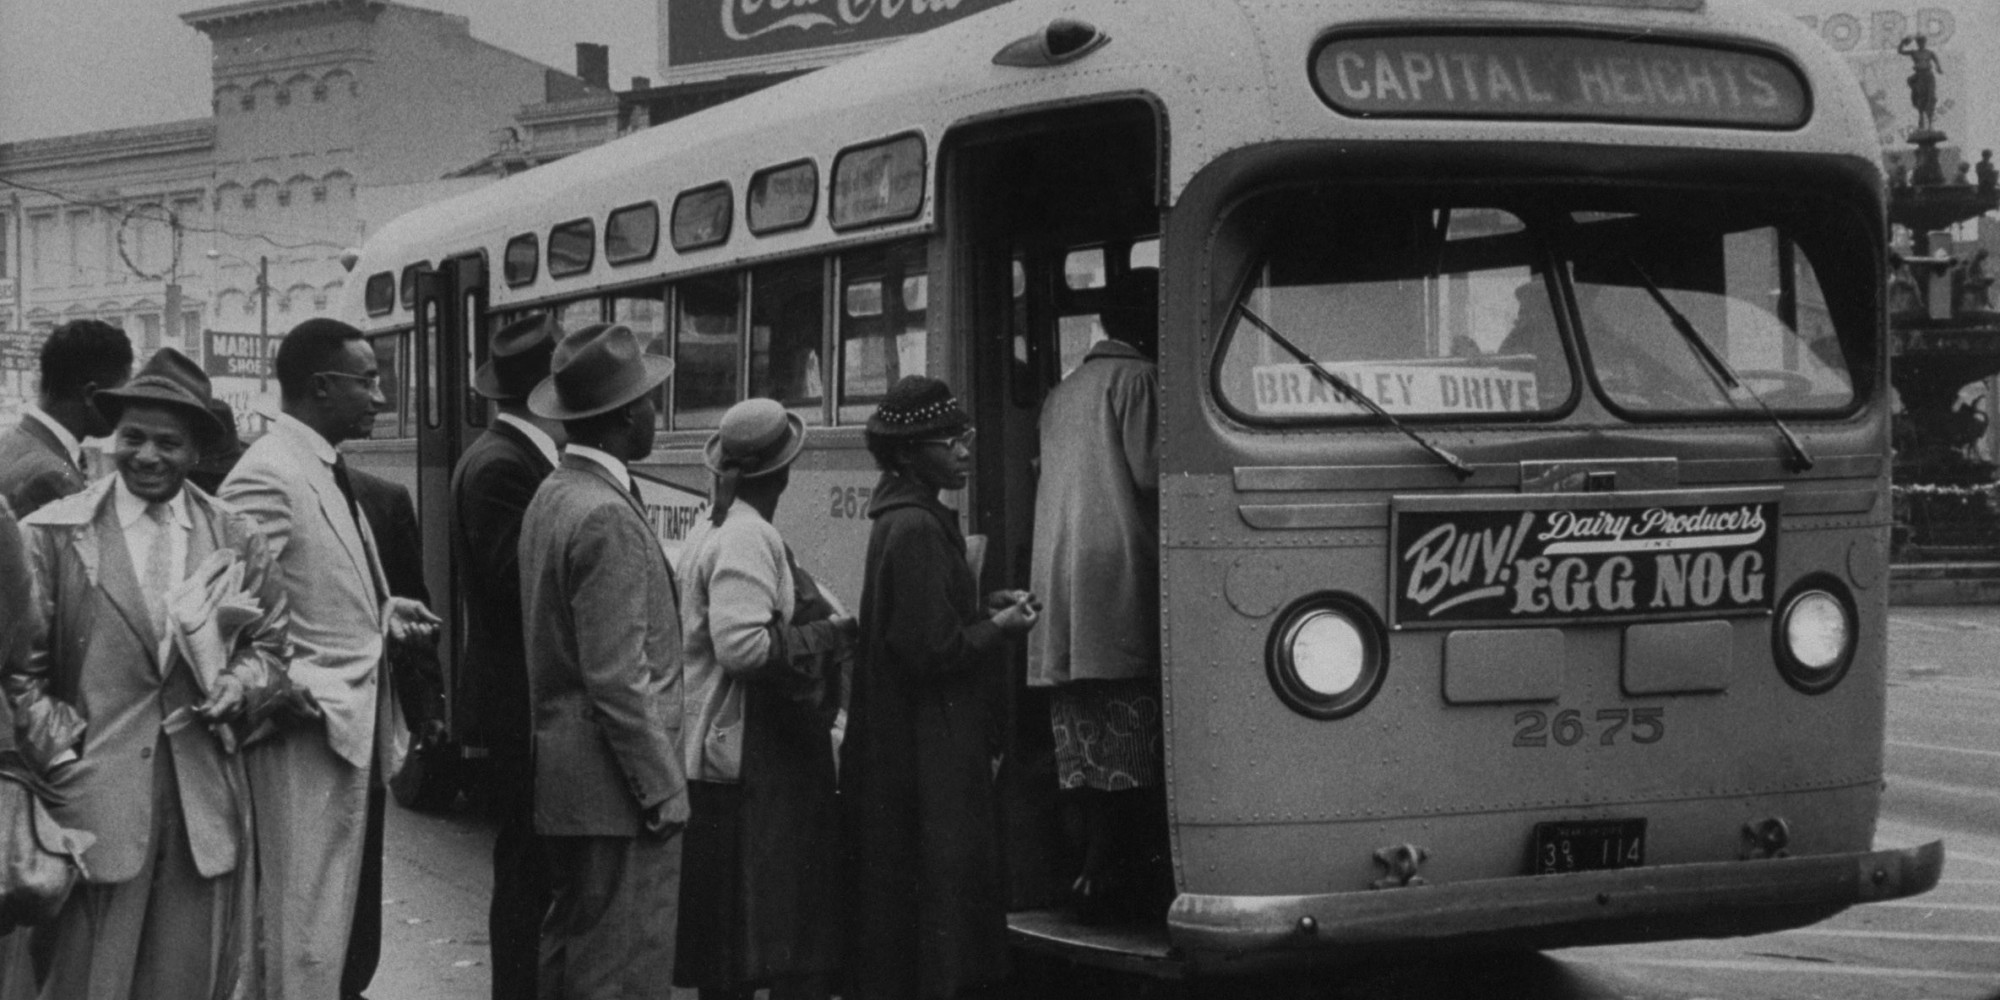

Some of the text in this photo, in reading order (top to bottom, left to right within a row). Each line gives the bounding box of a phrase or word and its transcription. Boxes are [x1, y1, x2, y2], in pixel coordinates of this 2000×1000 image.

[1335, 50, 1553, 101] CAPITAL
[213, 334, 281, 359] MARILN
[1440, 374, 1535, 411] DRIVE
[1538, 504, 1766, 542] Dairy Producers
[1510, 550, 1766, 614] EGG NOG
[1512, 707, 1665, 748] 2675
